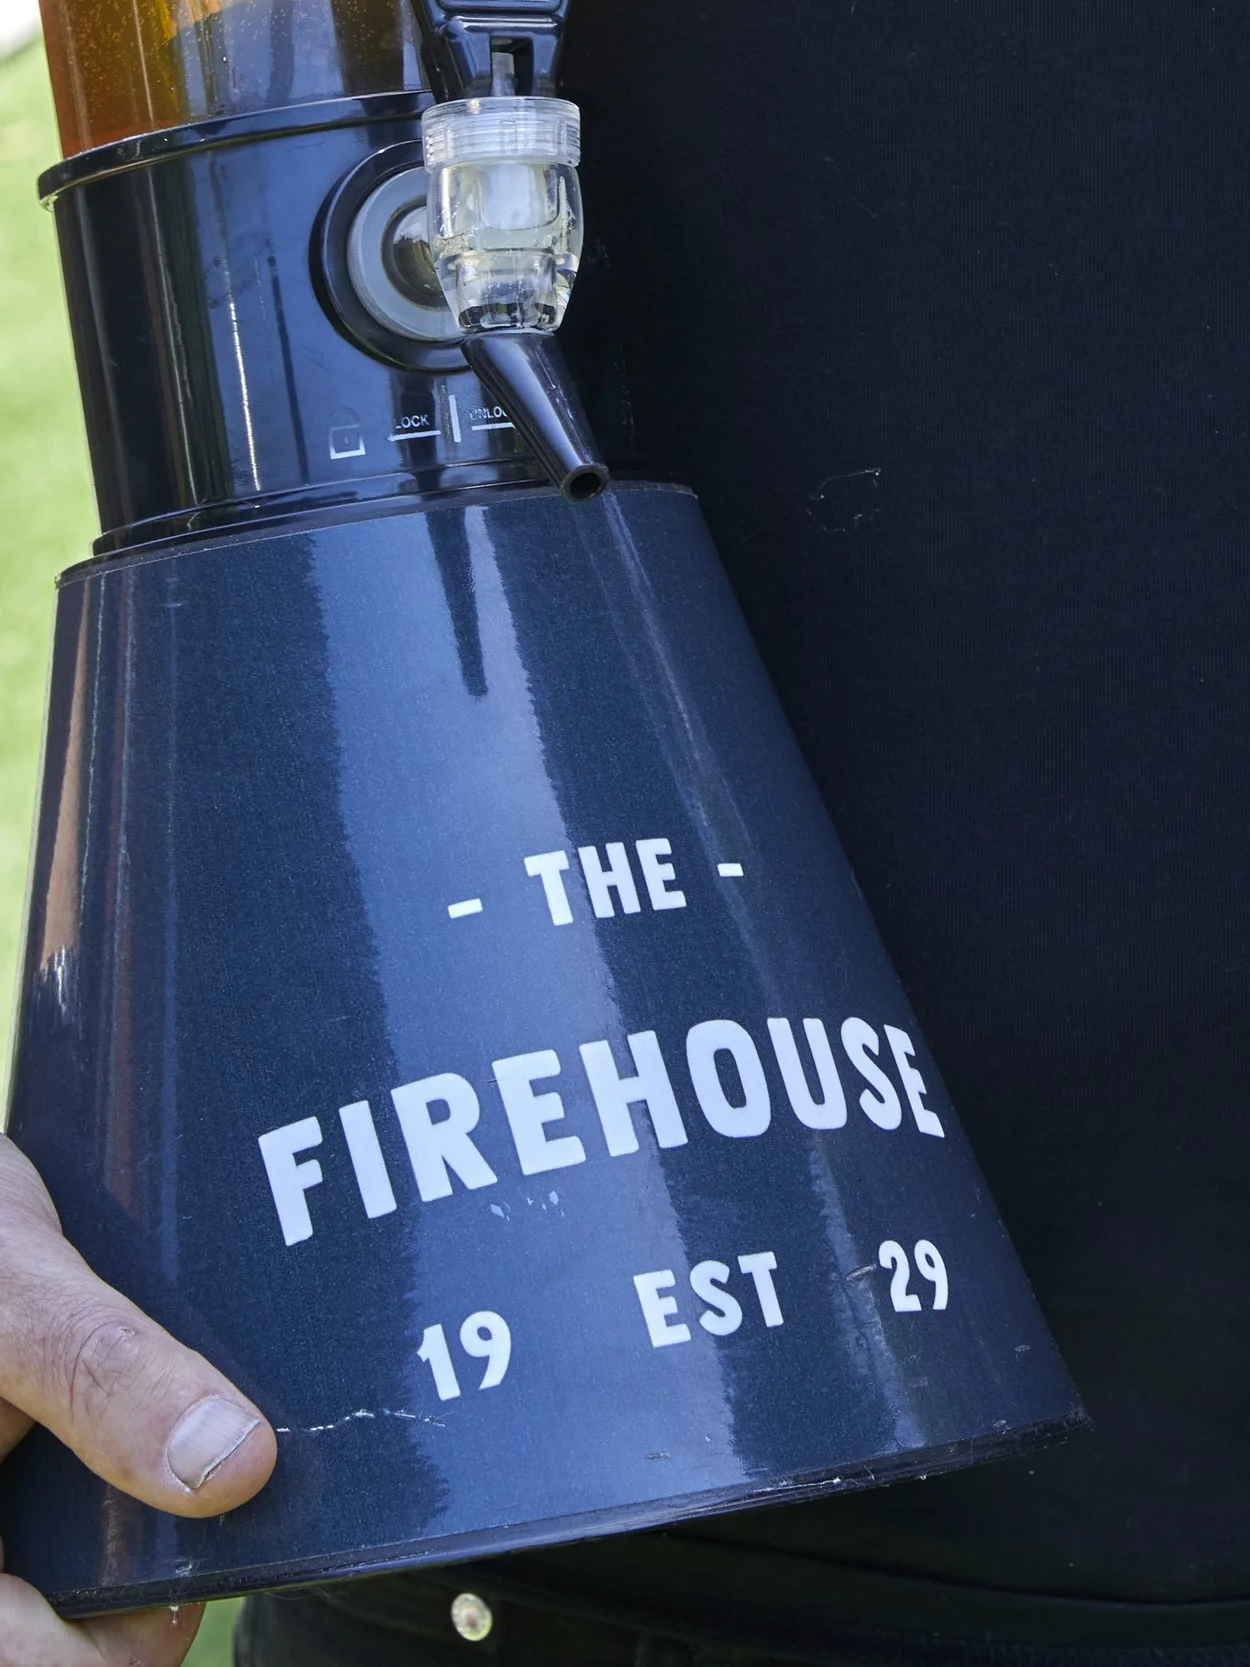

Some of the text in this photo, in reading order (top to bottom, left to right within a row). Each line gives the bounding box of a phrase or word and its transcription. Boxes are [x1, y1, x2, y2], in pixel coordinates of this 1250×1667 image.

[523, 837, 687, 926] THE
[257, 1016, 945, 1247] FIREHOUSE
[416, 1239, 949, 1401] 19 EST 29
